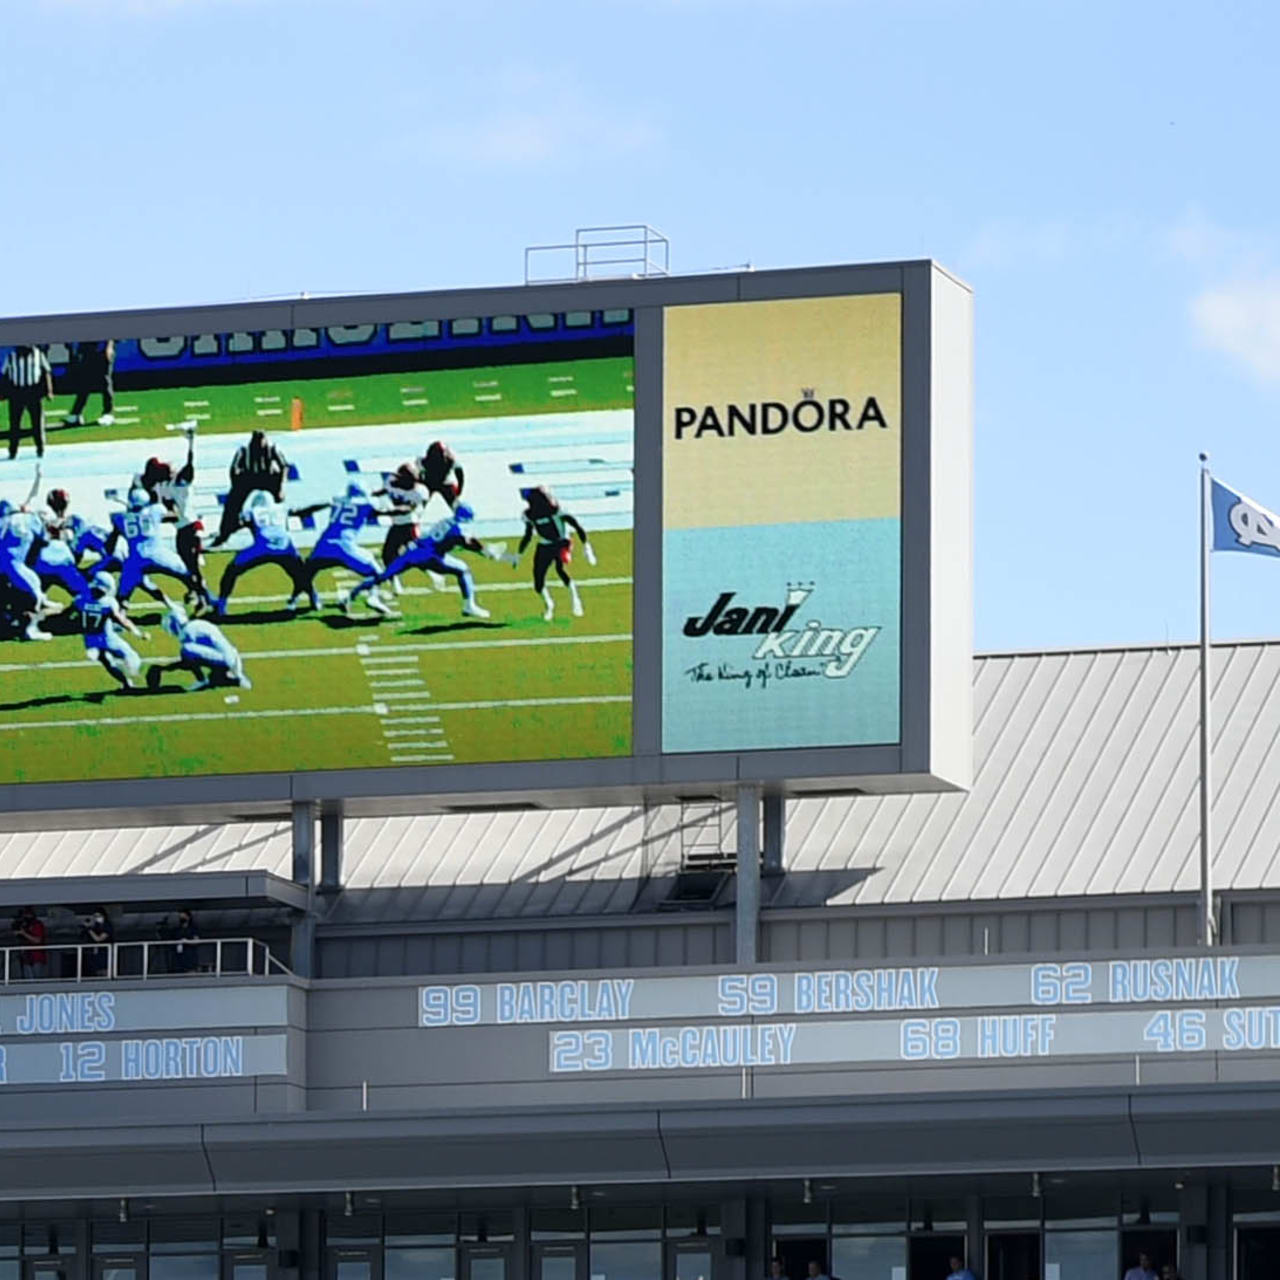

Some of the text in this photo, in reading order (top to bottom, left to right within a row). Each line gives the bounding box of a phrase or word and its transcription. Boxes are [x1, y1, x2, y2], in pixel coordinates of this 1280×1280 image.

[674, 396, 888, 440] PANDORA
[78, 610, 104, 632] 17
[682, 586, 814, 637] Jani
[422, 979, 635, 1026] 99 BARCLAY
[718, 967, 940, 1016] 59 BERSHAK
[1031, 957, 1241, 1005] 62 RUSNAK
[16, 991, 116, 1034] JONES
[1143, 1010, 1207, 1051] 46
[59, 1036, 245, 1082] 12 HORTON
[553, 1029, 614, 1071] 23
[900, 1014, 1057, 1060] 68 HUFF
